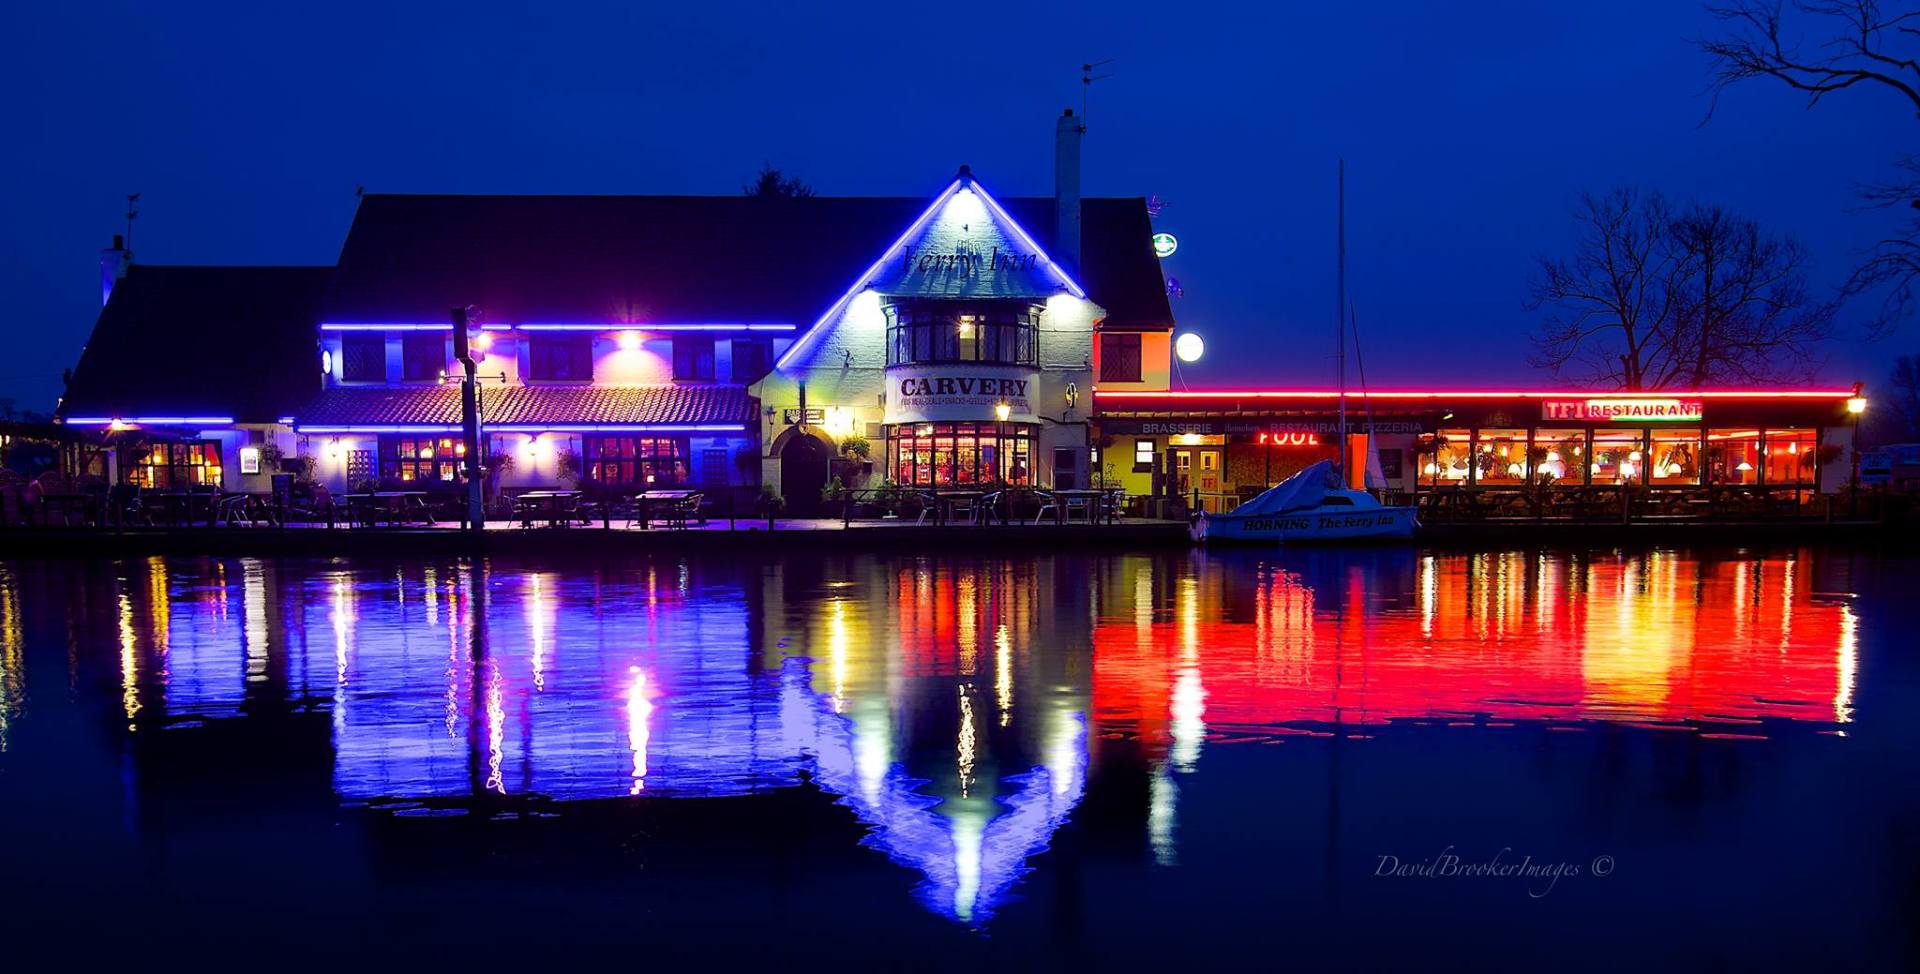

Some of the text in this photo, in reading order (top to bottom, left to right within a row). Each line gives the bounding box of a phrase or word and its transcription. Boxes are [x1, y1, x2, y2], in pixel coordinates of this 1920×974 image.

[903, 245, 1038, 279] Ferry Inn
[900, 377, 1028, 397] CARVERY
[786, 409, 801, 417] BAR
[1547, 402, 1701, 418] TFI RESTAURANT
[1142, 423, 1212, 433] BRASSERIE
[1361, 422, 1423, 433] PZZERIA
[1243, 518, 1310, 531] HORNING
